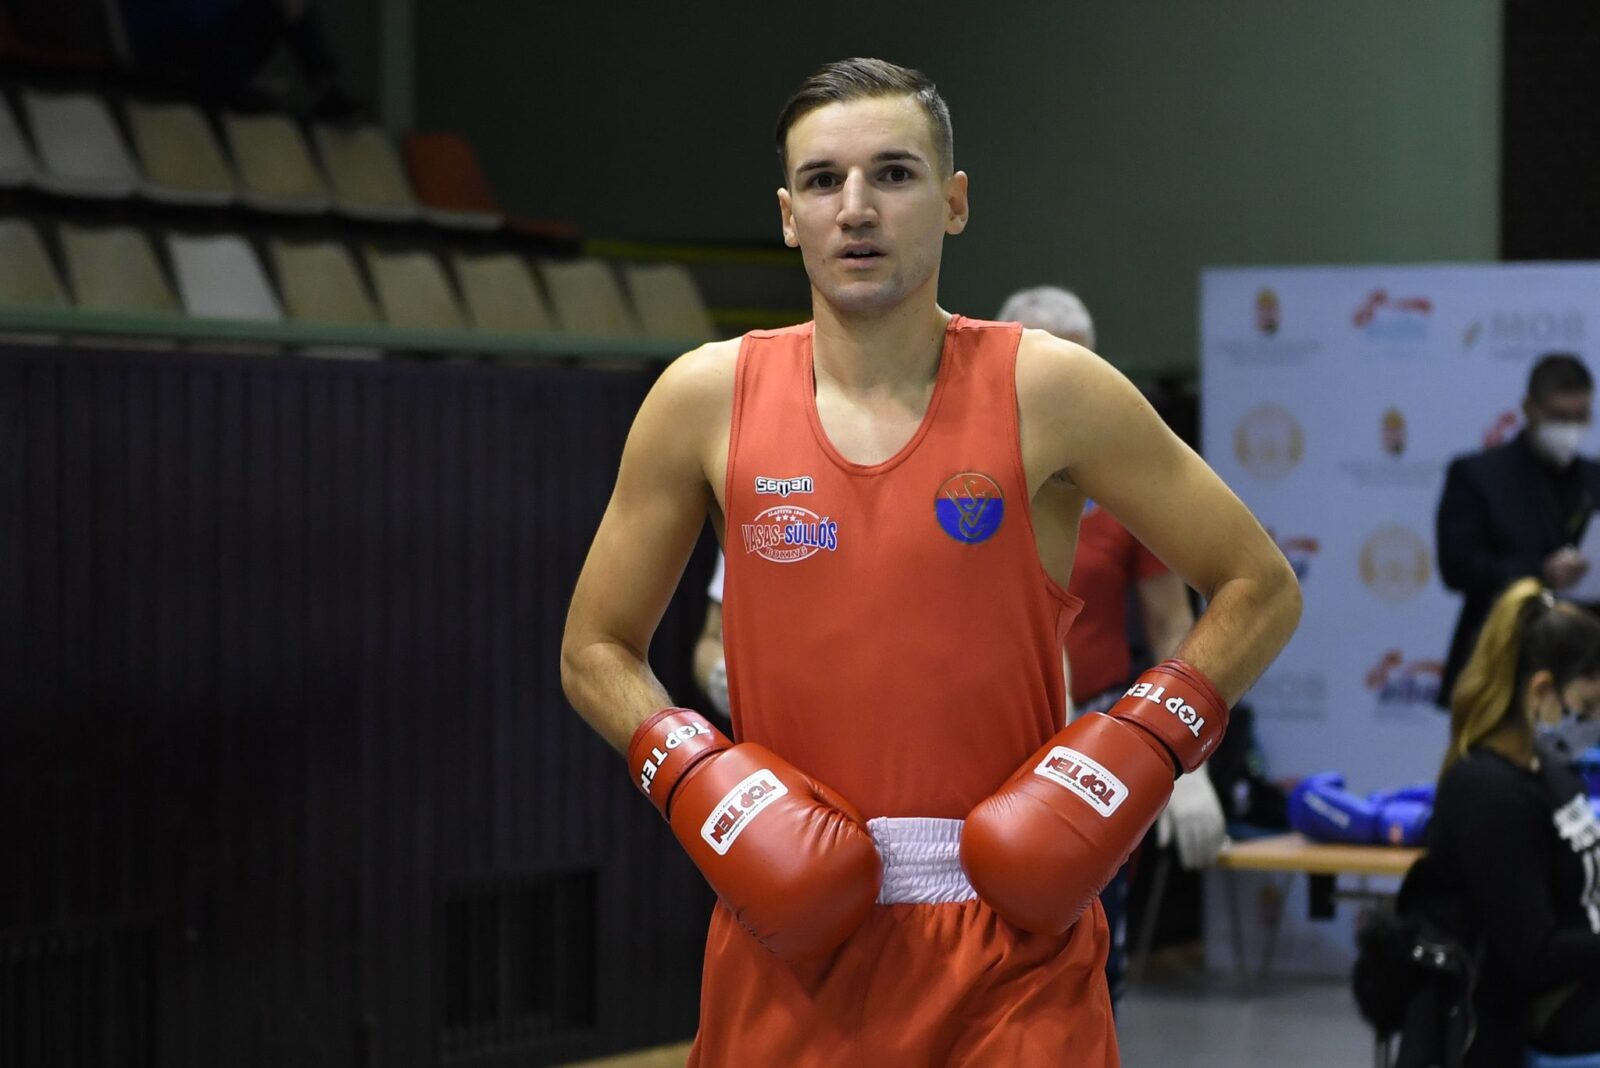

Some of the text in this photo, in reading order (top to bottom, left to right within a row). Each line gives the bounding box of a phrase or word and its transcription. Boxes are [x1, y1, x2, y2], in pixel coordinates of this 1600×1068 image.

[742, 516, 838, 554] VASAS-SÜLLŐS
[765, 546, 808, 560] BOXING
[1165, 697, 1205, 737] TOP
[640, 722, 711, 794] TOP TEN
[1045, 755, 1116, 808] TOP TEN
[710, 779, 777, 845] TOP TEN
